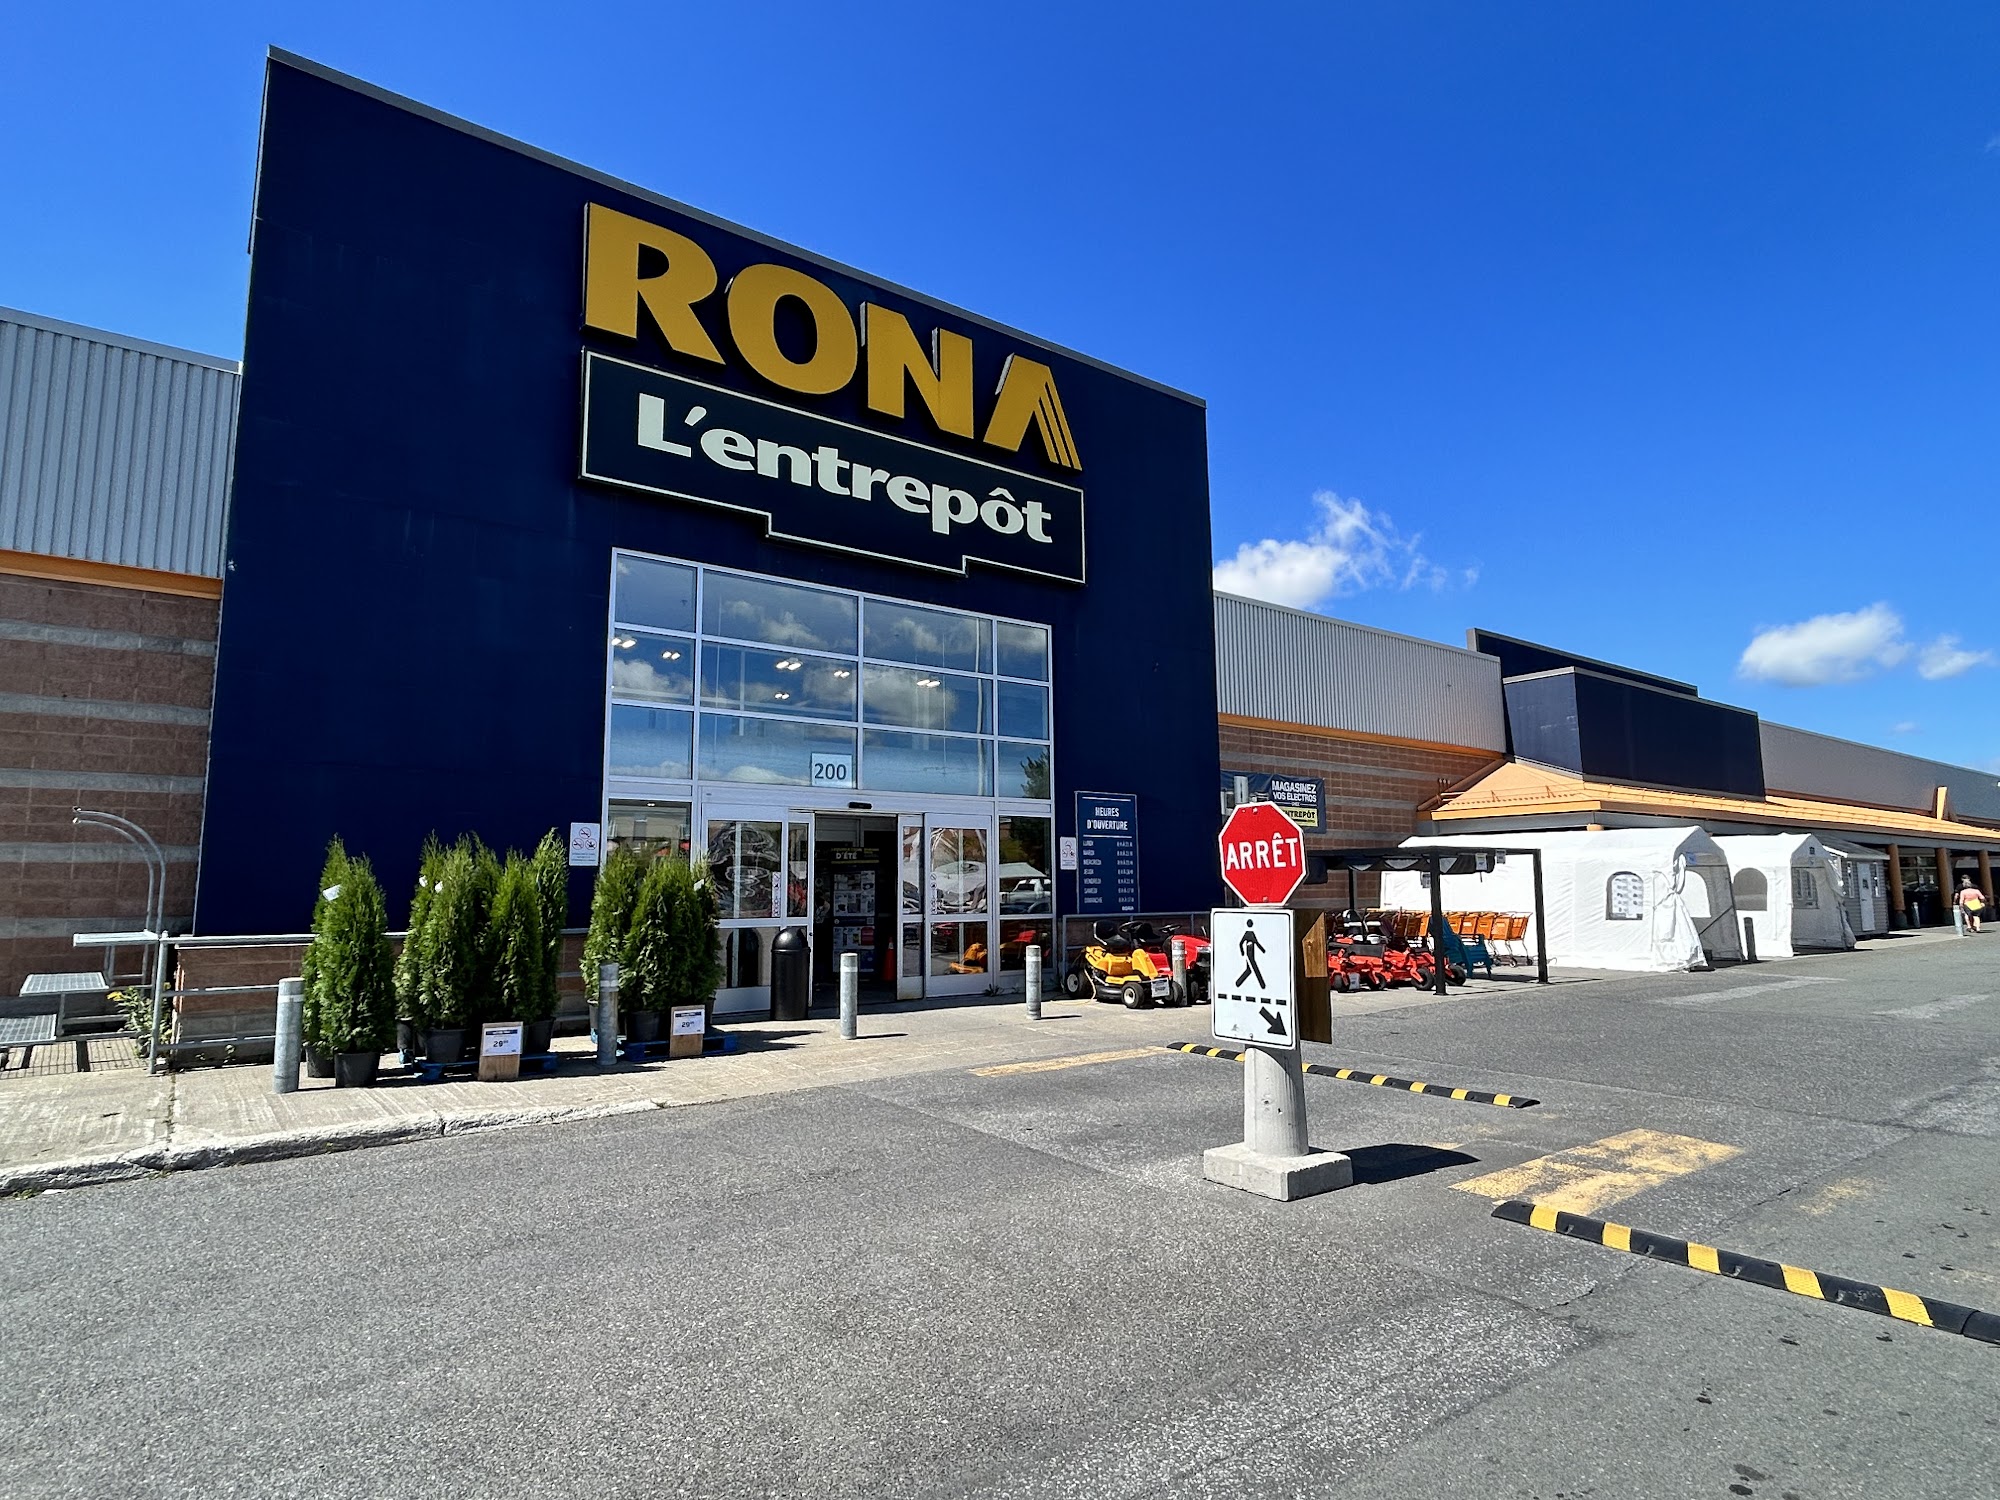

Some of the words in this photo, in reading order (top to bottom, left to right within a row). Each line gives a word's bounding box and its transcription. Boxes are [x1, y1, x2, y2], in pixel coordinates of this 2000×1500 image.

[583, 202, 1082, 471] RONA
[637, 392, 1053, 543] L'entrepôt
[814, 763, 847, 780] 200
[1272, 781, 1317, 794] MAGASINEZ
[1273, 792, 1286, 800] VOS
[1095, 806, 1119, 817] HEURES
[1086, 819, 1128, 830] D'OUVERTURE
[1226, 832, 1298, 871] ARRÊT
